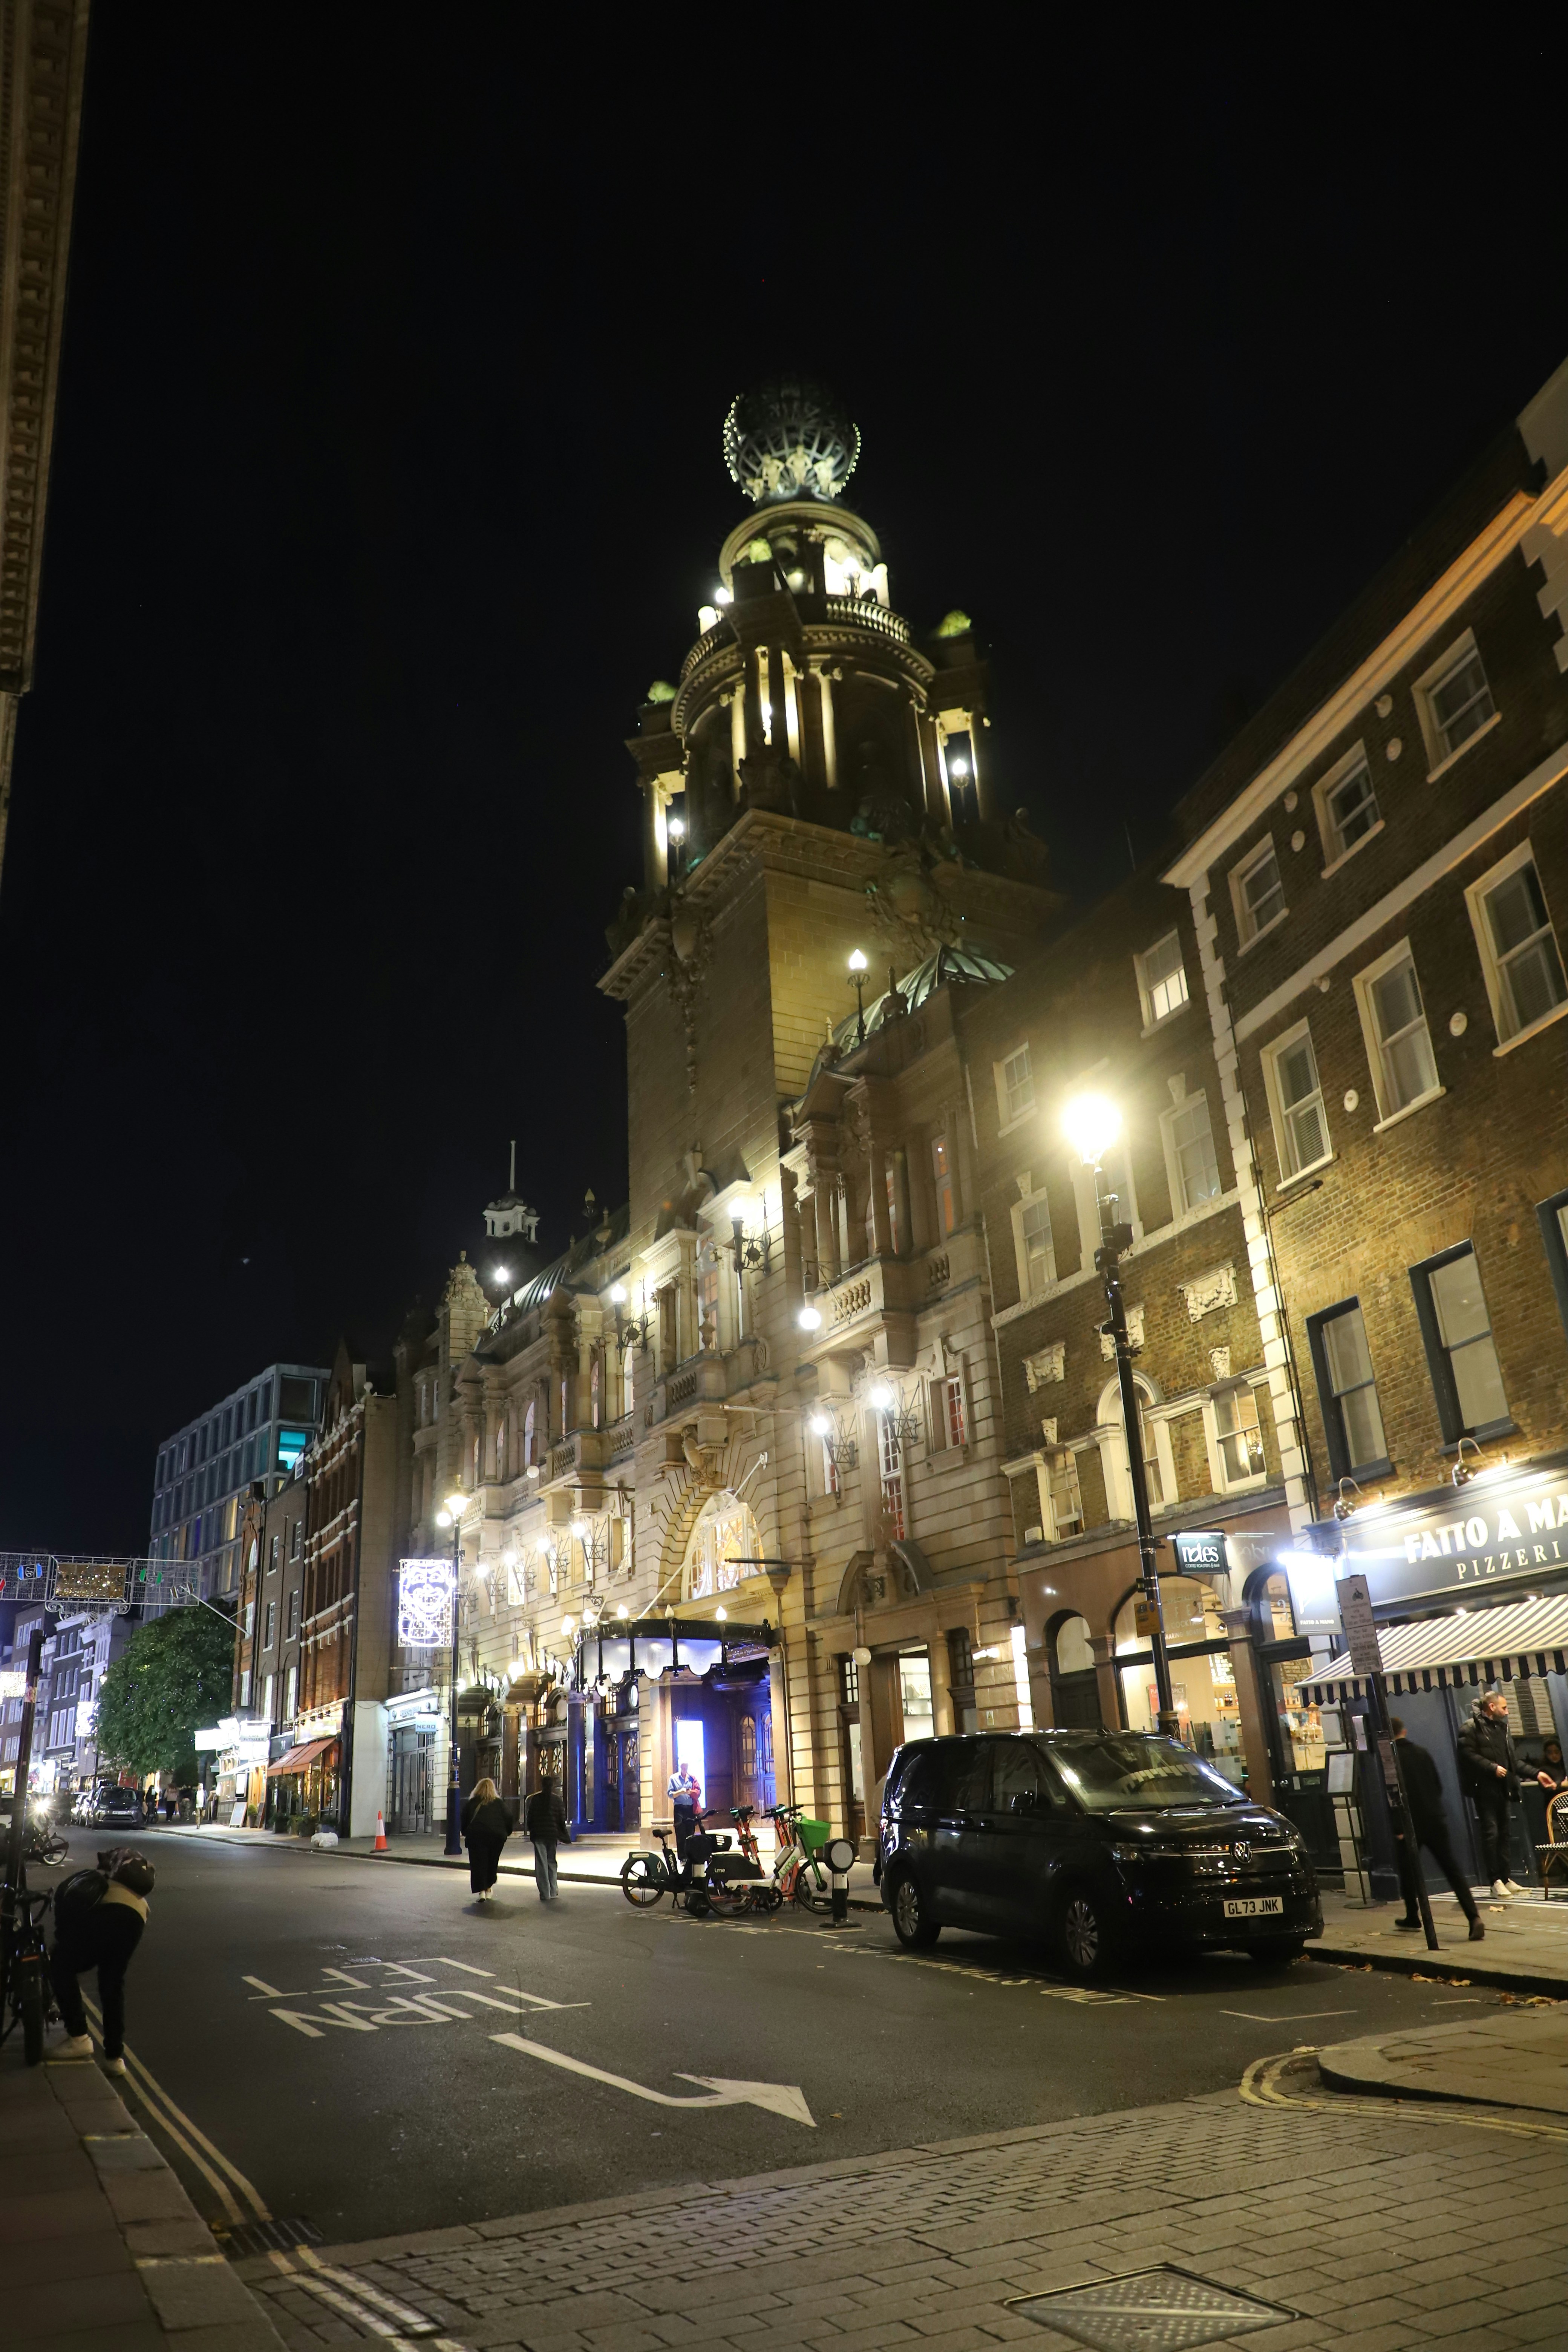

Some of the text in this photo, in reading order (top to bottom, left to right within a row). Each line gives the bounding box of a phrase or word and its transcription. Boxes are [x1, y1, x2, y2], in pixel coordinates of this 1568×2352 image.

[1404, 1517, 1488, 1564] FATTO
[1497, 1509, 1522, 1542] A
[1228, 1899, 1278, 1915] GL73 JNK
[242, 1957, 497, 2000] LEFT
[268, 1986, 592, 2037] TURN
